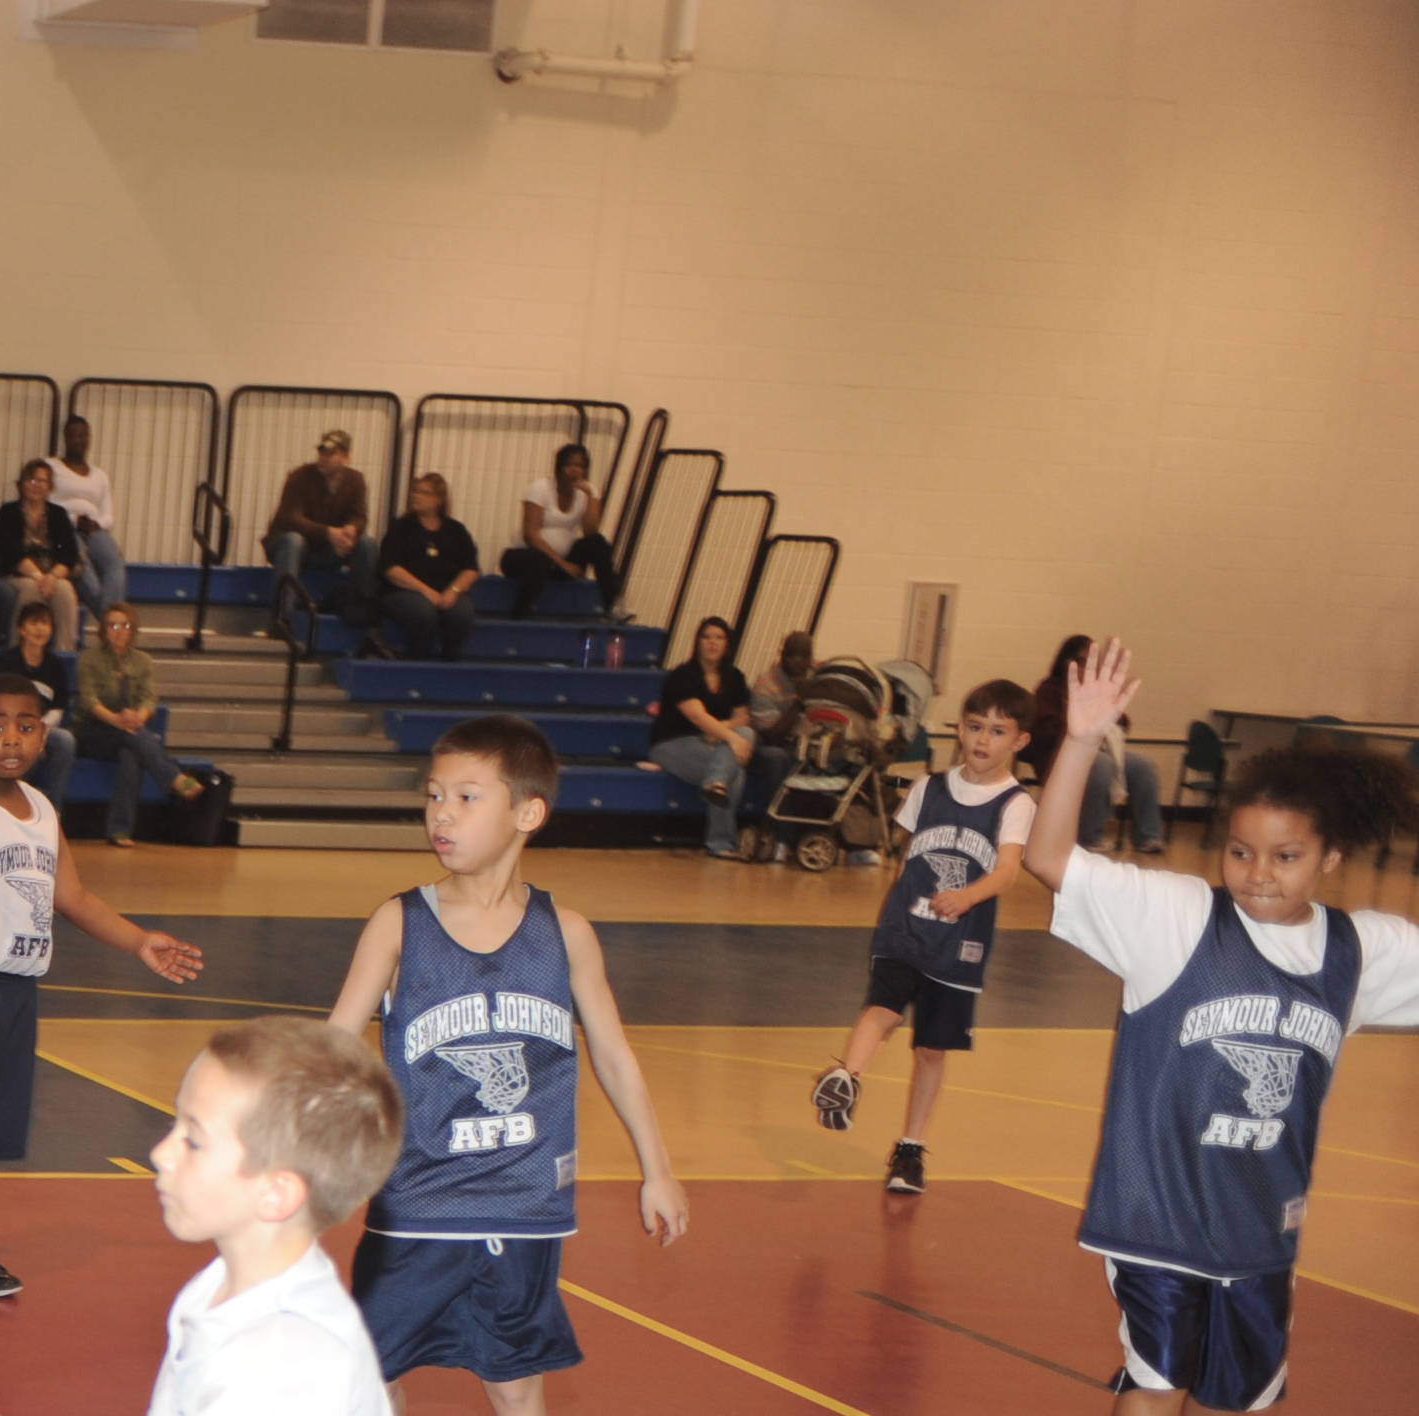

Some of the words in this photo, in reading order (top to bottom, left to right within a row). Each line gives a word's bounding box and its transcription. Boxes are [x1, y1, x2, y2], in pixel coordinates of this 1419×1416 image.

[8, 933, 51, 958] AFB
[405, 992, 490, 1064] SEYMOUR
[492, 991, 573, 1050] JOHNSON
[1179, 995, 1280, 1047] SEYMOUR
[449, 1111, 535, 1153] AFB
[1200, 1114, 1285, 1150] AFB
